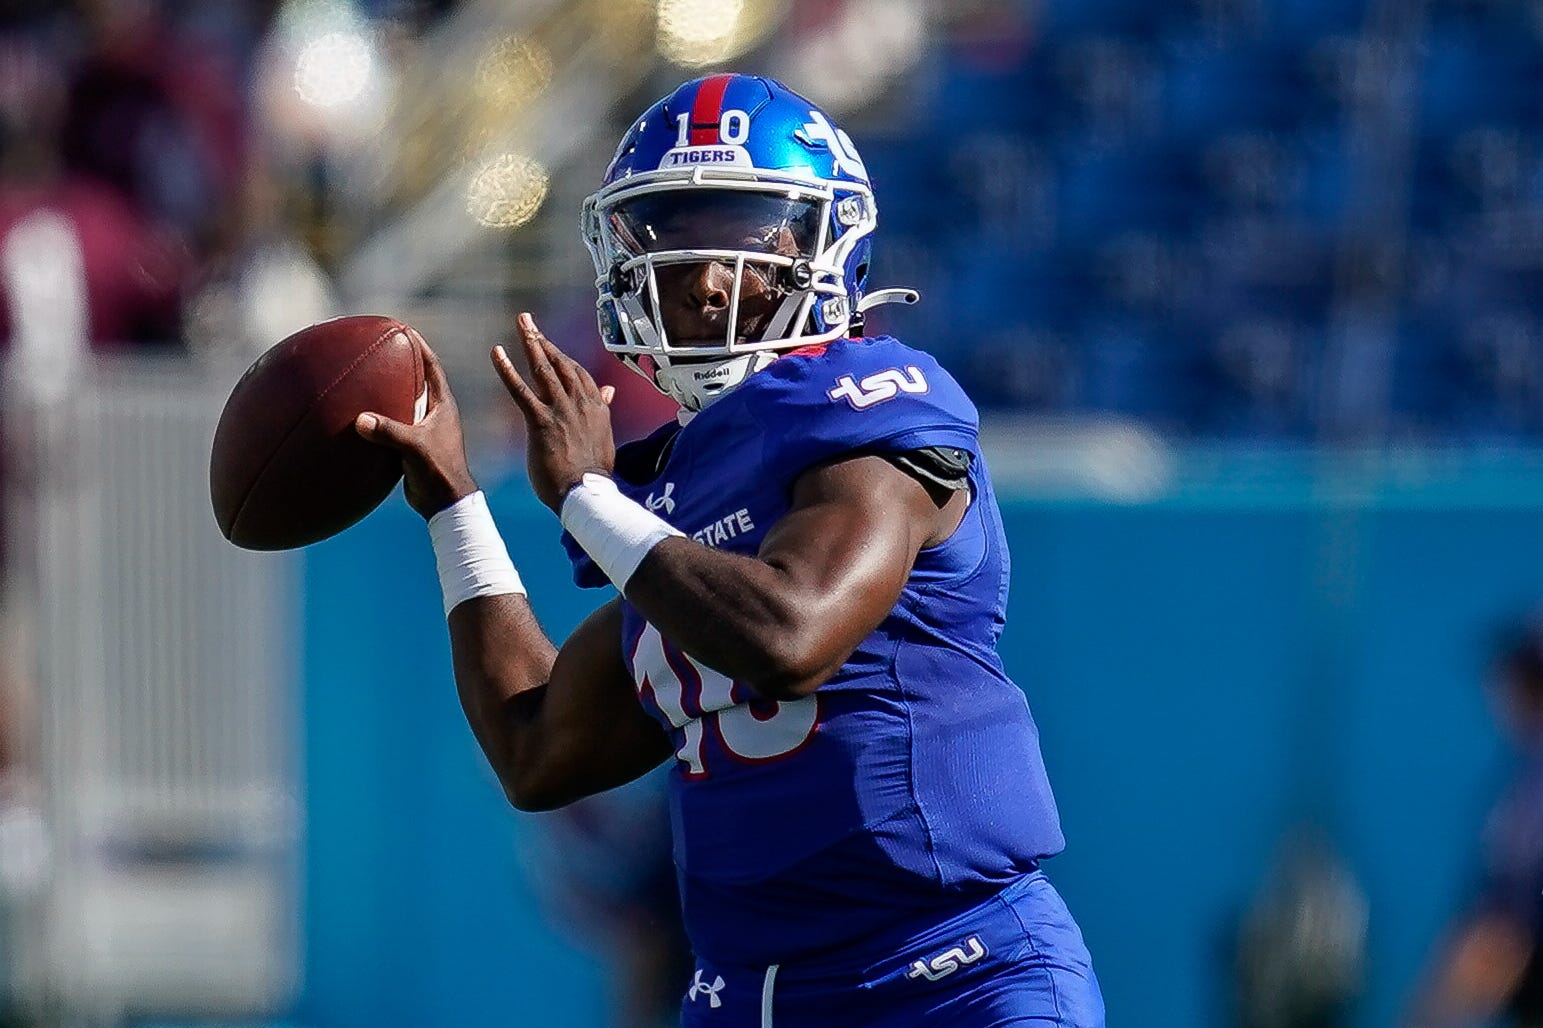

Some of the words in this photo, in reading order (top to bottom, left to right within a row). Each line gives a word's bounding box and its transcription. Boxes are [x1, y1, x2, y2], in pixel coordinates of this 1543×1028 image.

[675, 109, 750, 147] 10
[671, 150, 735, 165] TIGERS
[694, 367, 729, 381] Riddell
